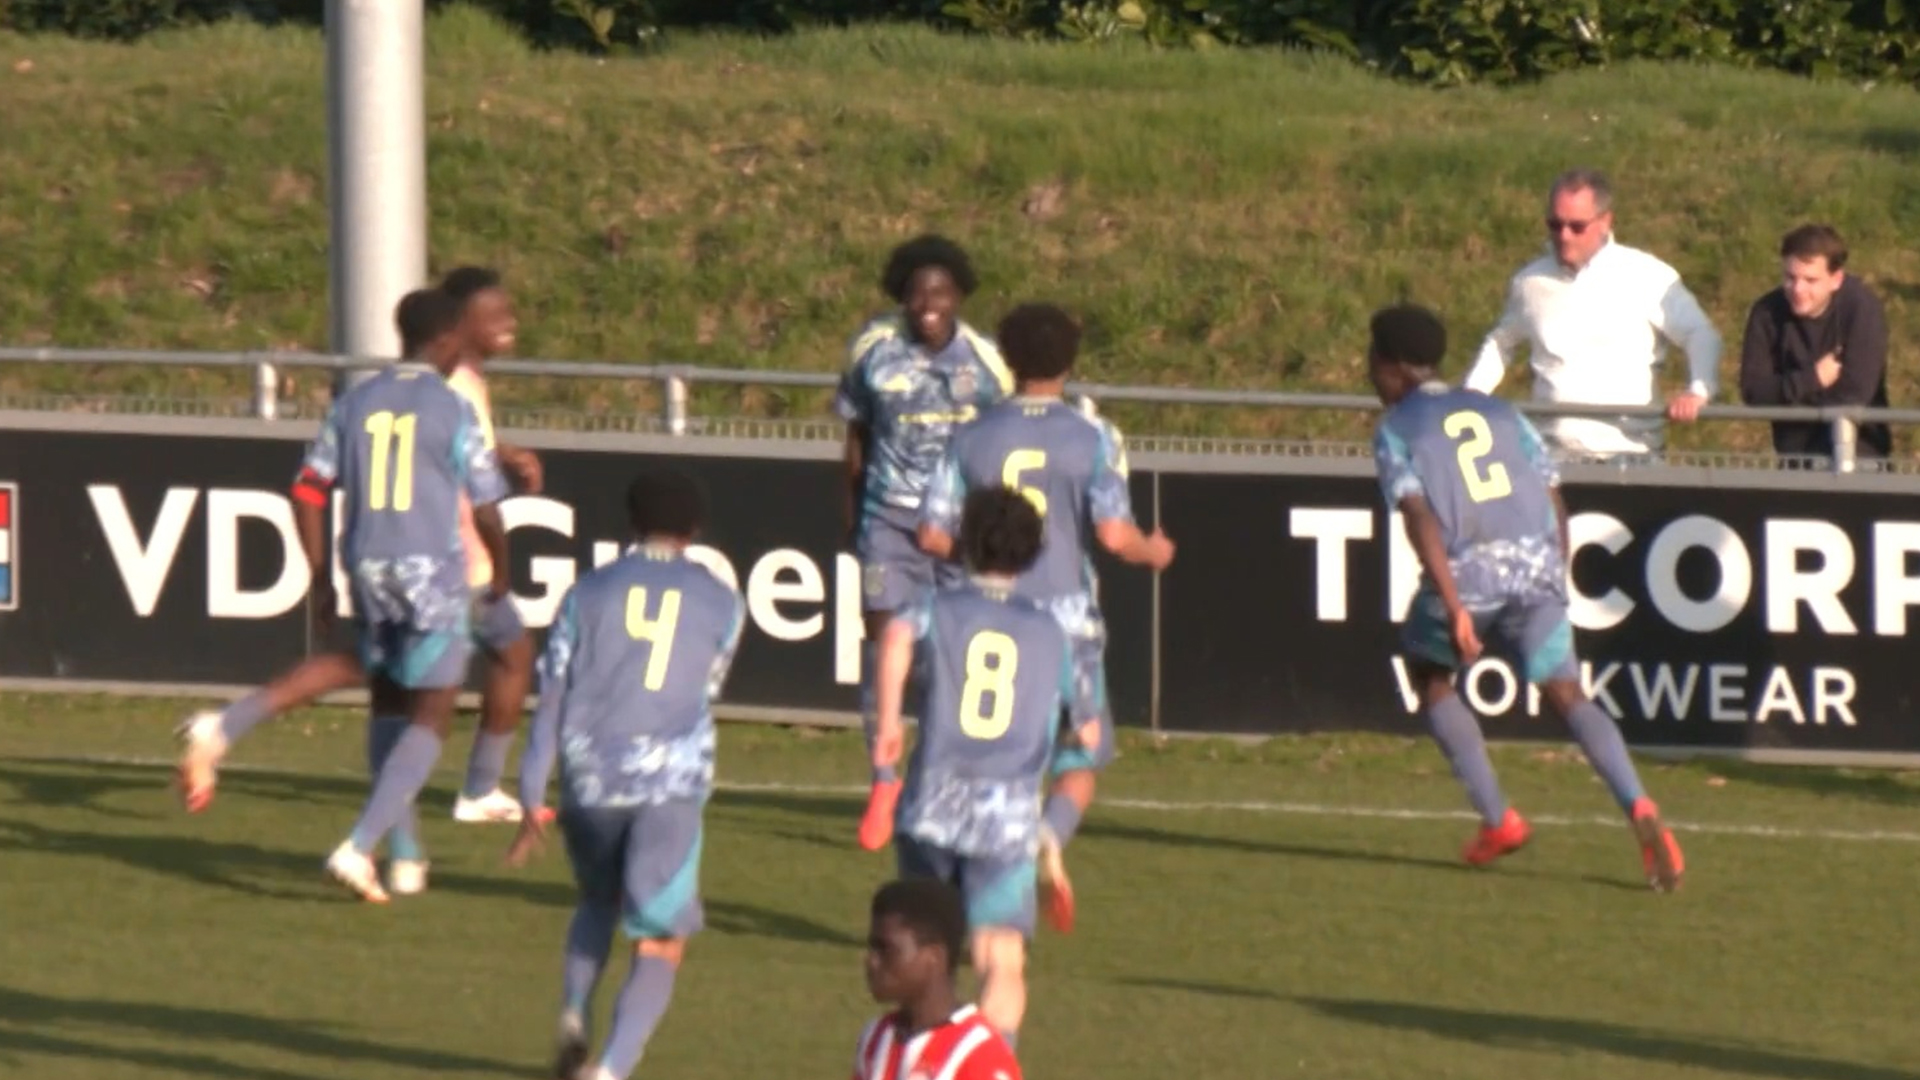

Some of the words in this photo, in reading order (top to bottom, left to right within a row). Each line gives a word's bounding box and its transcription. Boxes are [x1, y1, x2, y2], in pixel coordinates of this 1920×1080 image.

[364, 411, 416, 511] 11
[1443, 410, 1513, 503] 2
[1290, 508, 1920, 636] TCORP
[625, 587, 681, 691] 4
[959, 630, 1018, 739] 8
[1392, 655, 1857, 725] OKWEAR
